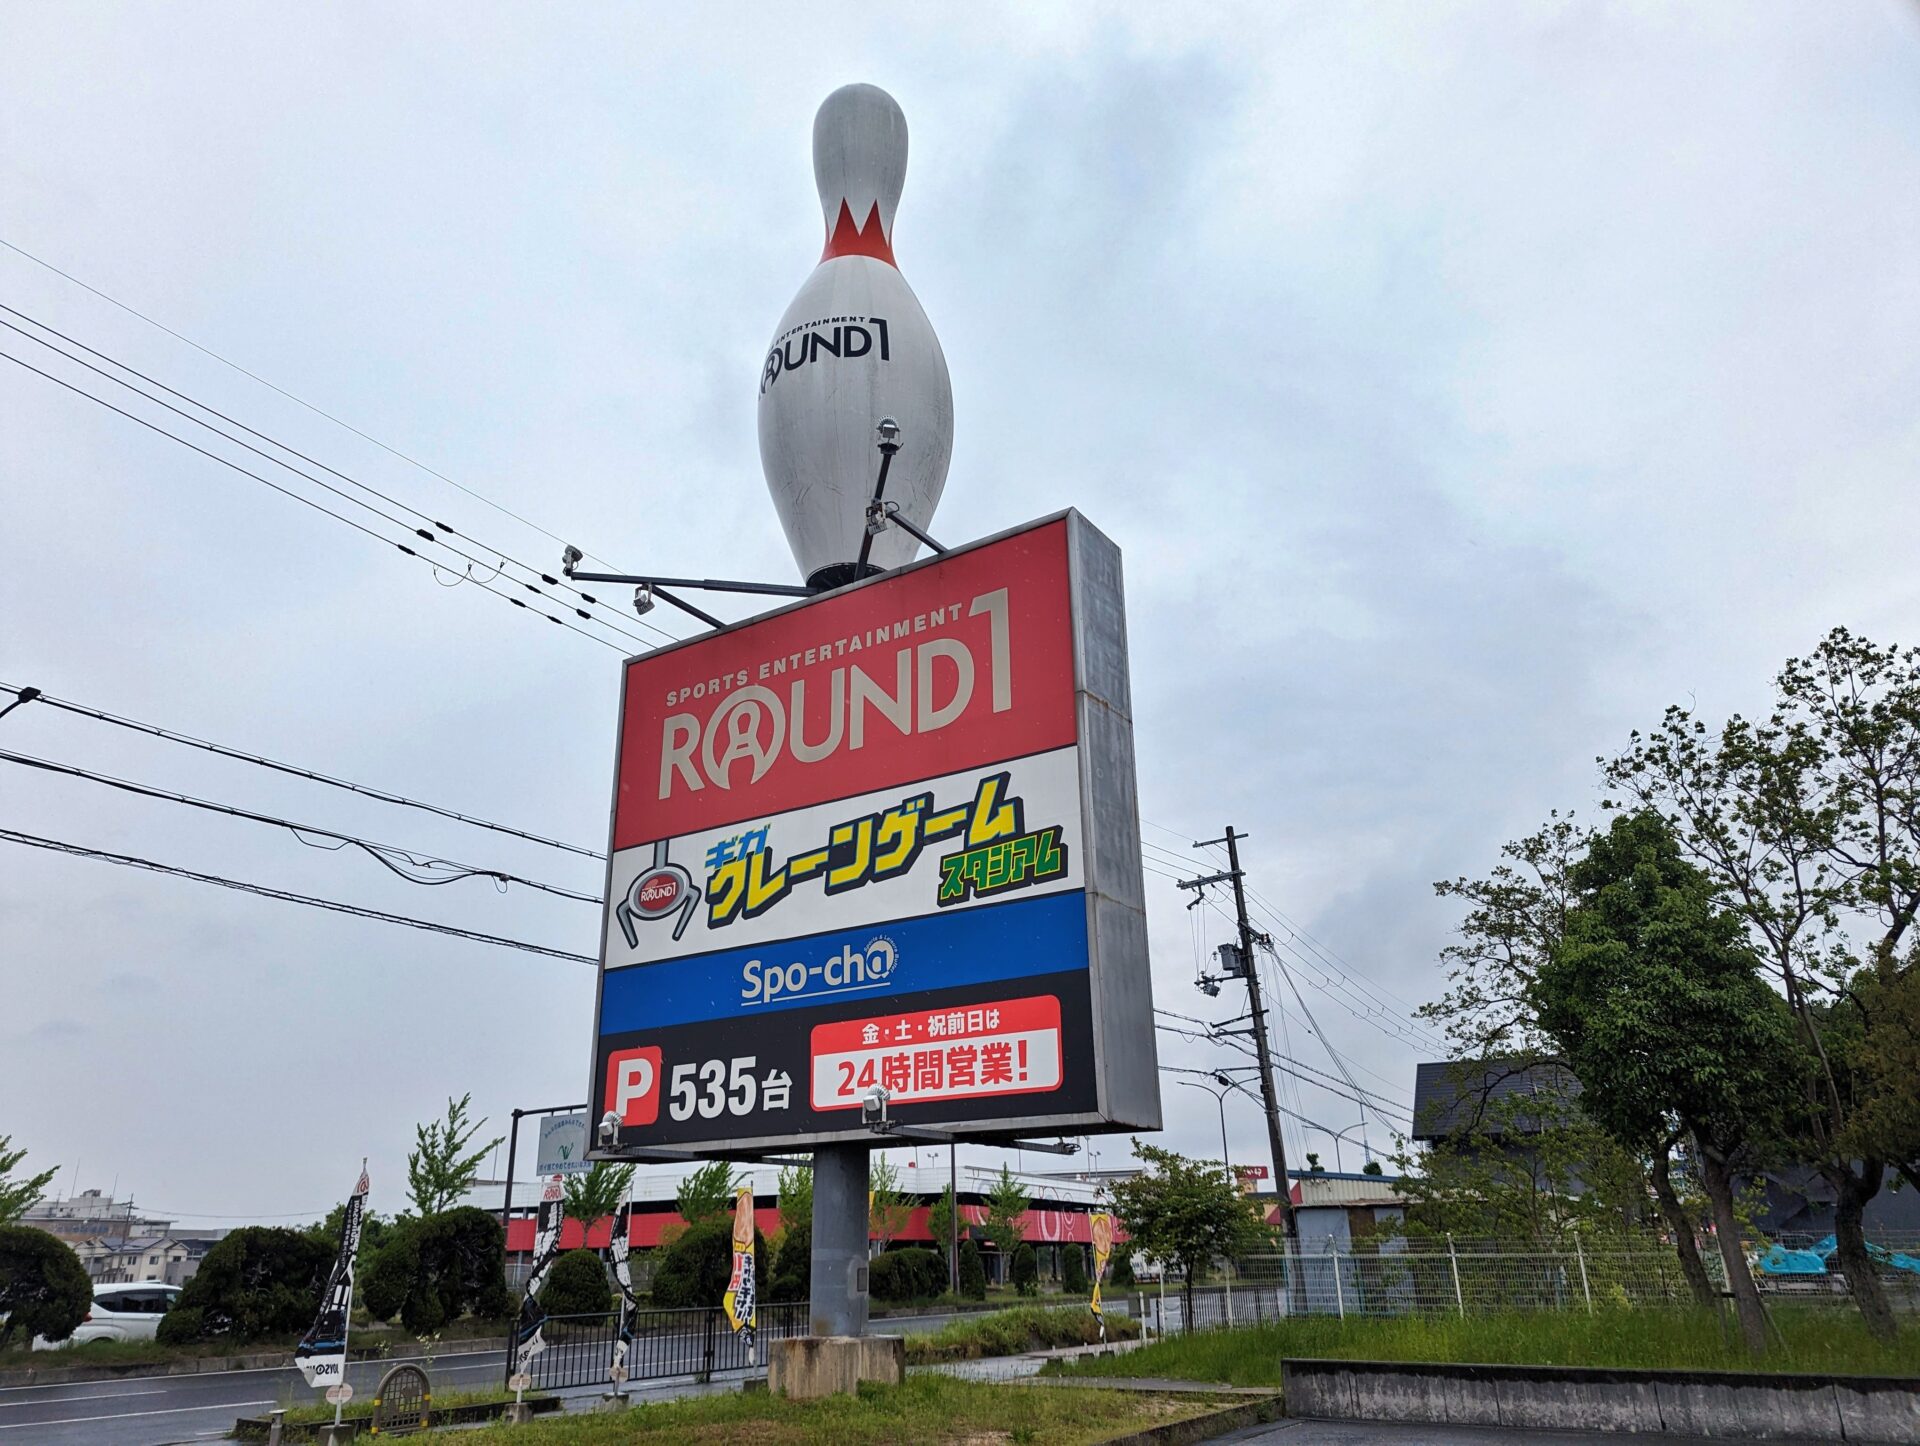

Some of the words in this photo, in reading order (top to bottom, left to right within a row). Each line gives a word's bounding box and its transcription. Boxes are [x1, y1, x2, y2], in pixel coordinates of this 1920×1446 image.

[759, 317, 890, 400] OUND1
[776, 316, 866, 346] ENTERTAINMENT
[666, 670, 749, 707] SPORTS
[759, 603, 963, 680] ENTERTAINMENT
[658, 587, 1012, 800] ROUND1
[705, 823, 771, 868] ギガ
[708, 774, 1019, 927] クレーンゲーム
[941, 828, 1066, 904] スタジアム
[640, 881, 677, 902] ROUND1
[615, 1058, 654, 1117] P
[669, 1056, 793, 1122] 535台
